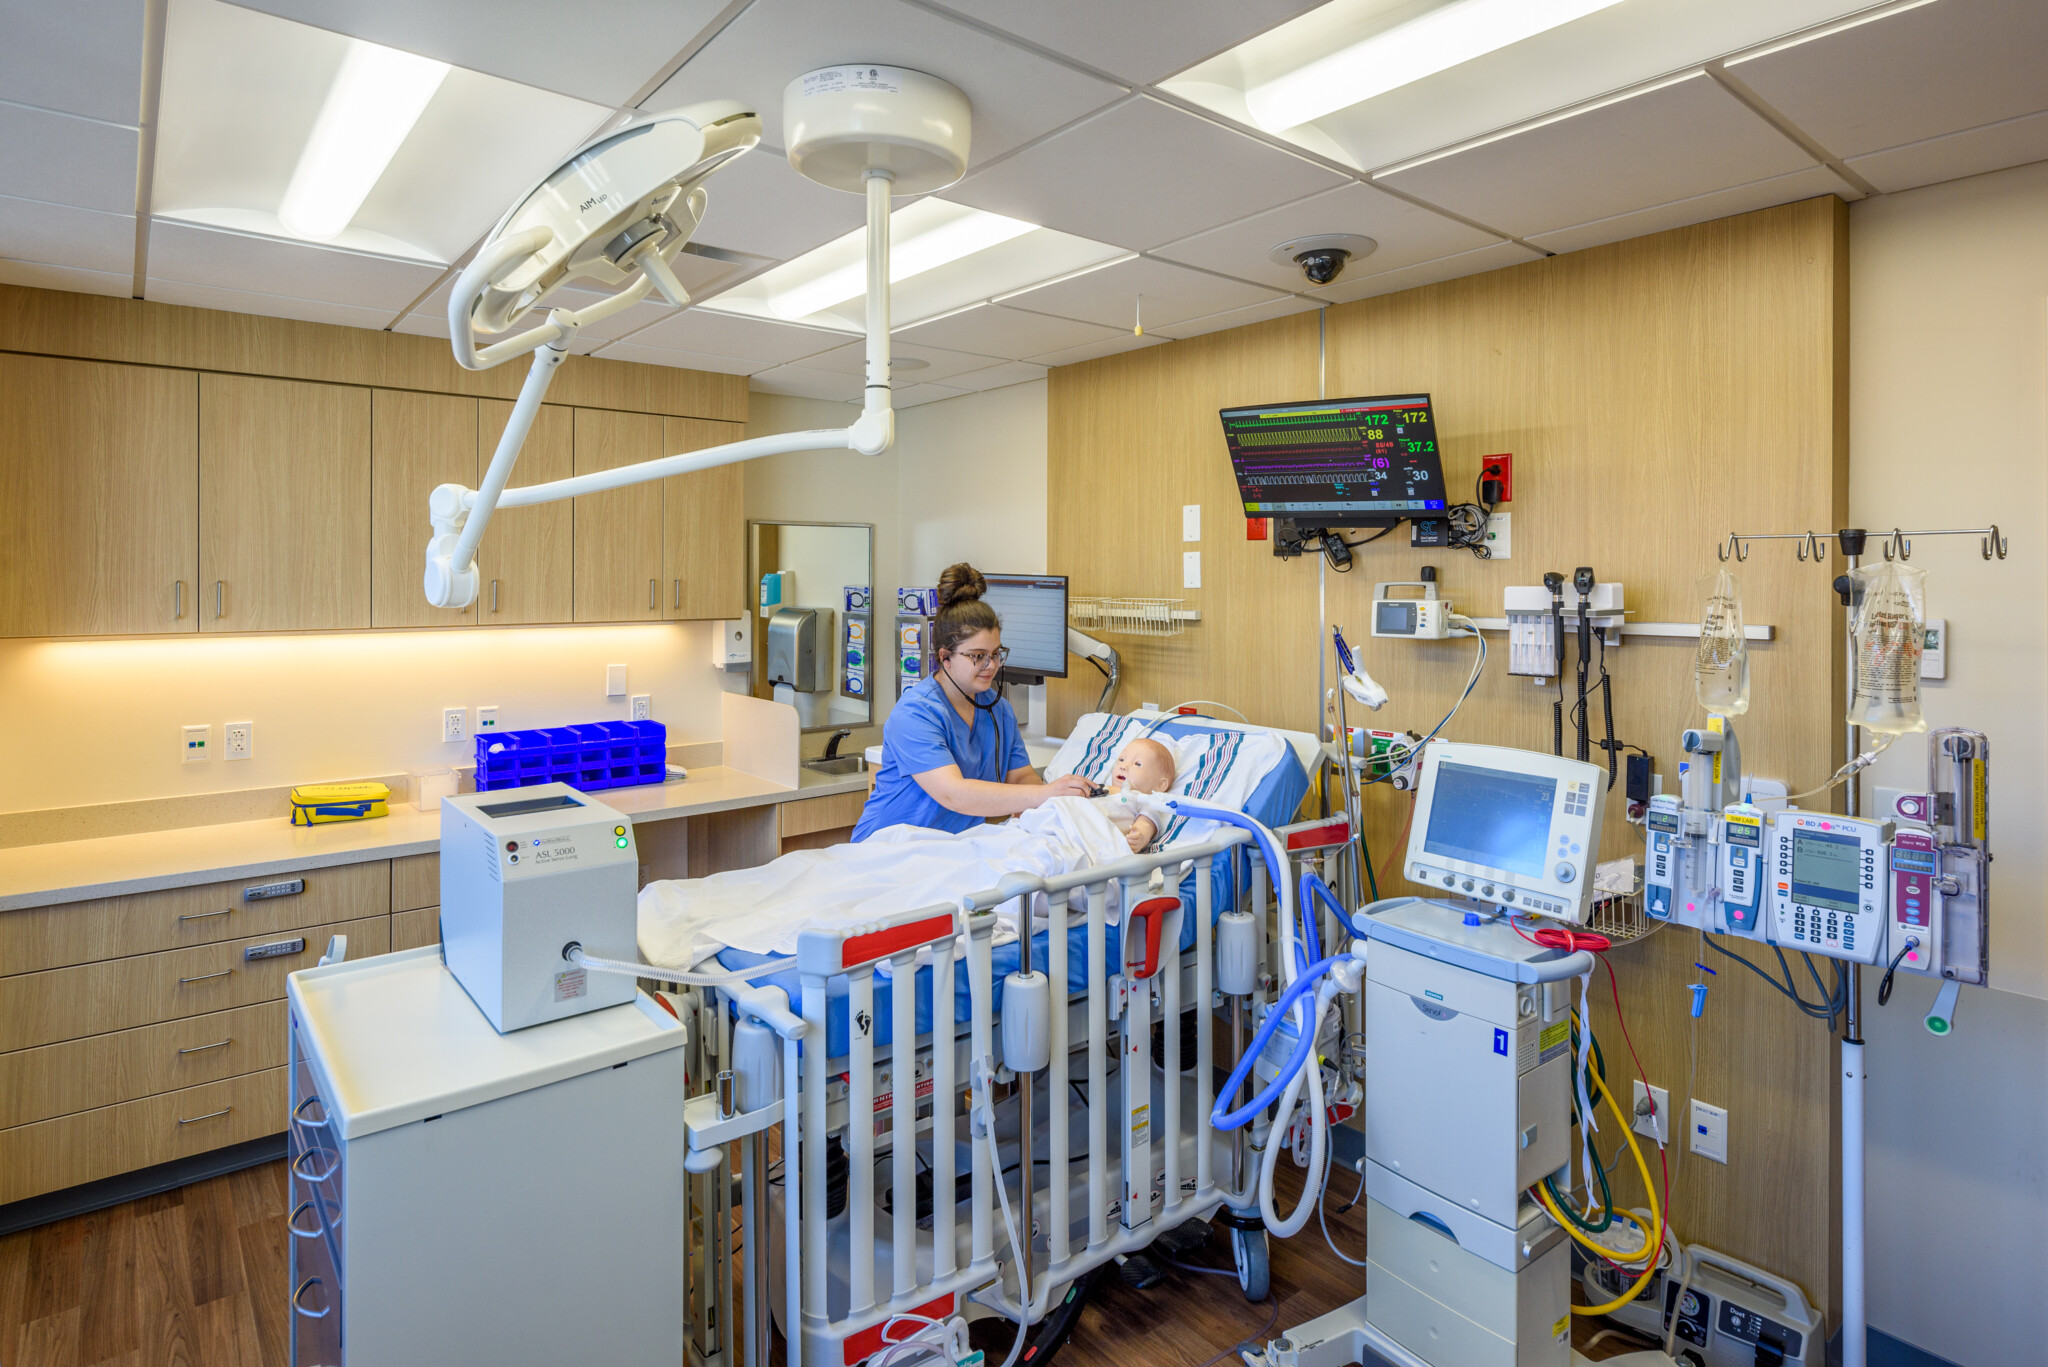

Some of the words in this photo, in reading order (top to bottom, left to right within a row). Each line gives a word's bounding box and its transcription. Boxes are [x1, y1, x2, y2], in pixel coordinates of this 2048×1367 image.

[579, 197, 597, 213] AIM
[597, 194, 608, 204] LED
[1364, 414, 1389, 425] 172
[1402, 411, 1428, 423] 172
[1367, 429, 1384, 440] 88
[1407, 441, 1435, 452] 37.2
[1372, 457, 1390, 469] (6)
[1374, 471, 1388, 480] 34
[1412, 470, 1429, 481] 30
[1742, 817, 1754, 825] LAB
[1737, 826, 1751, 835] 25
[1842, 825, 1857, 833] PCU
[536, 850, 551, 860] ASL
[554, 846, 576, 857] 5000
[1497, 1034, 1505, 1051] 1
[1729, 1306, 1746, 1319] Duet
